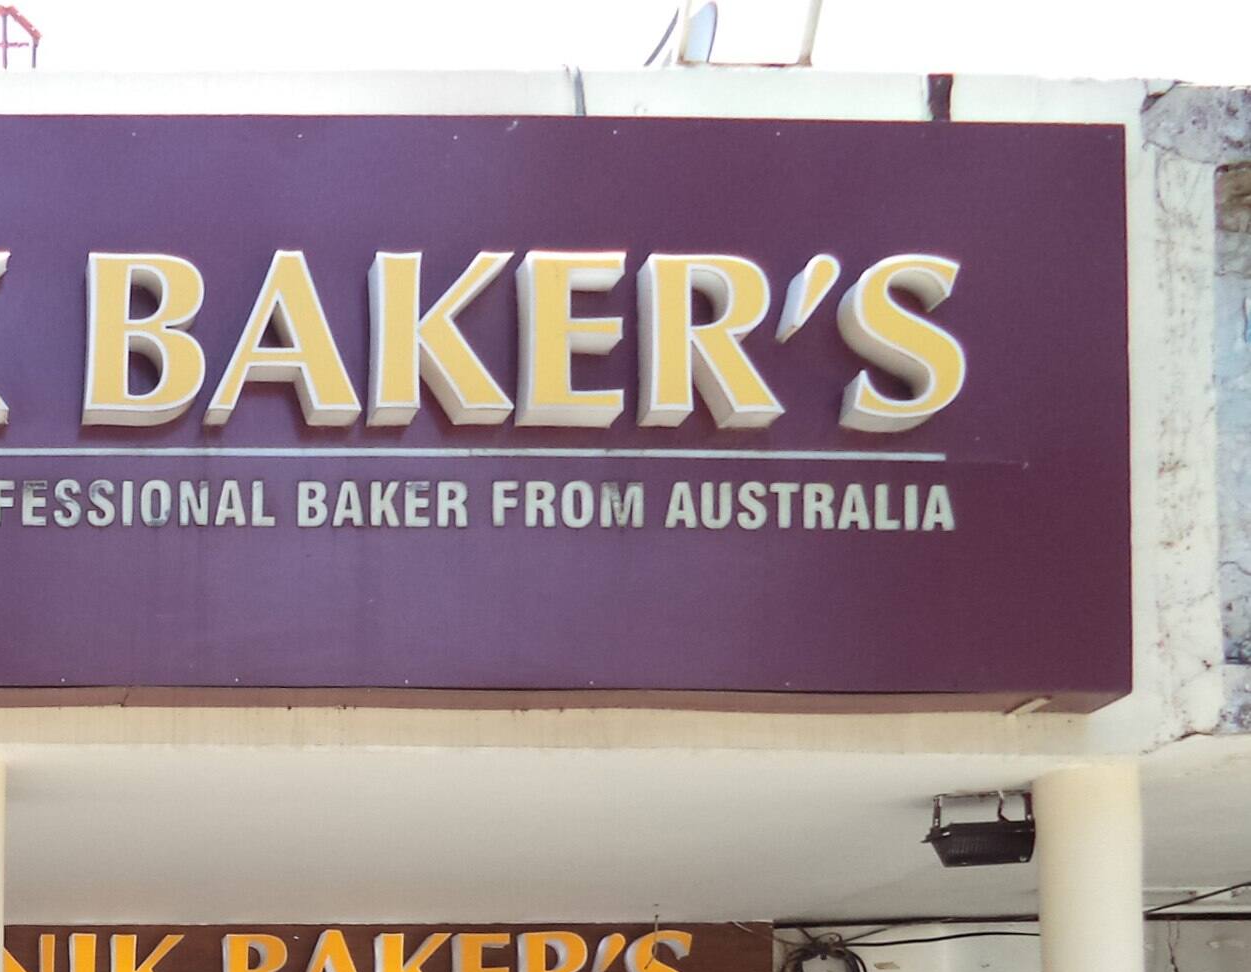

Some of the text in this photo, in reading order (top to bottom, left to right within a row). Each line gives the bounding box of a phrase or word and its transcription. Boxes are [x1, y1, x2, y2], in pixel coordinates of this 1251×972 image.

[81, 249, 966, 433] BAKER'S
[296, 480, 469, 529] BAKER
[491, 480, 645, 529] FROM
[664, 481, 956, 532] AUSTRALIA
